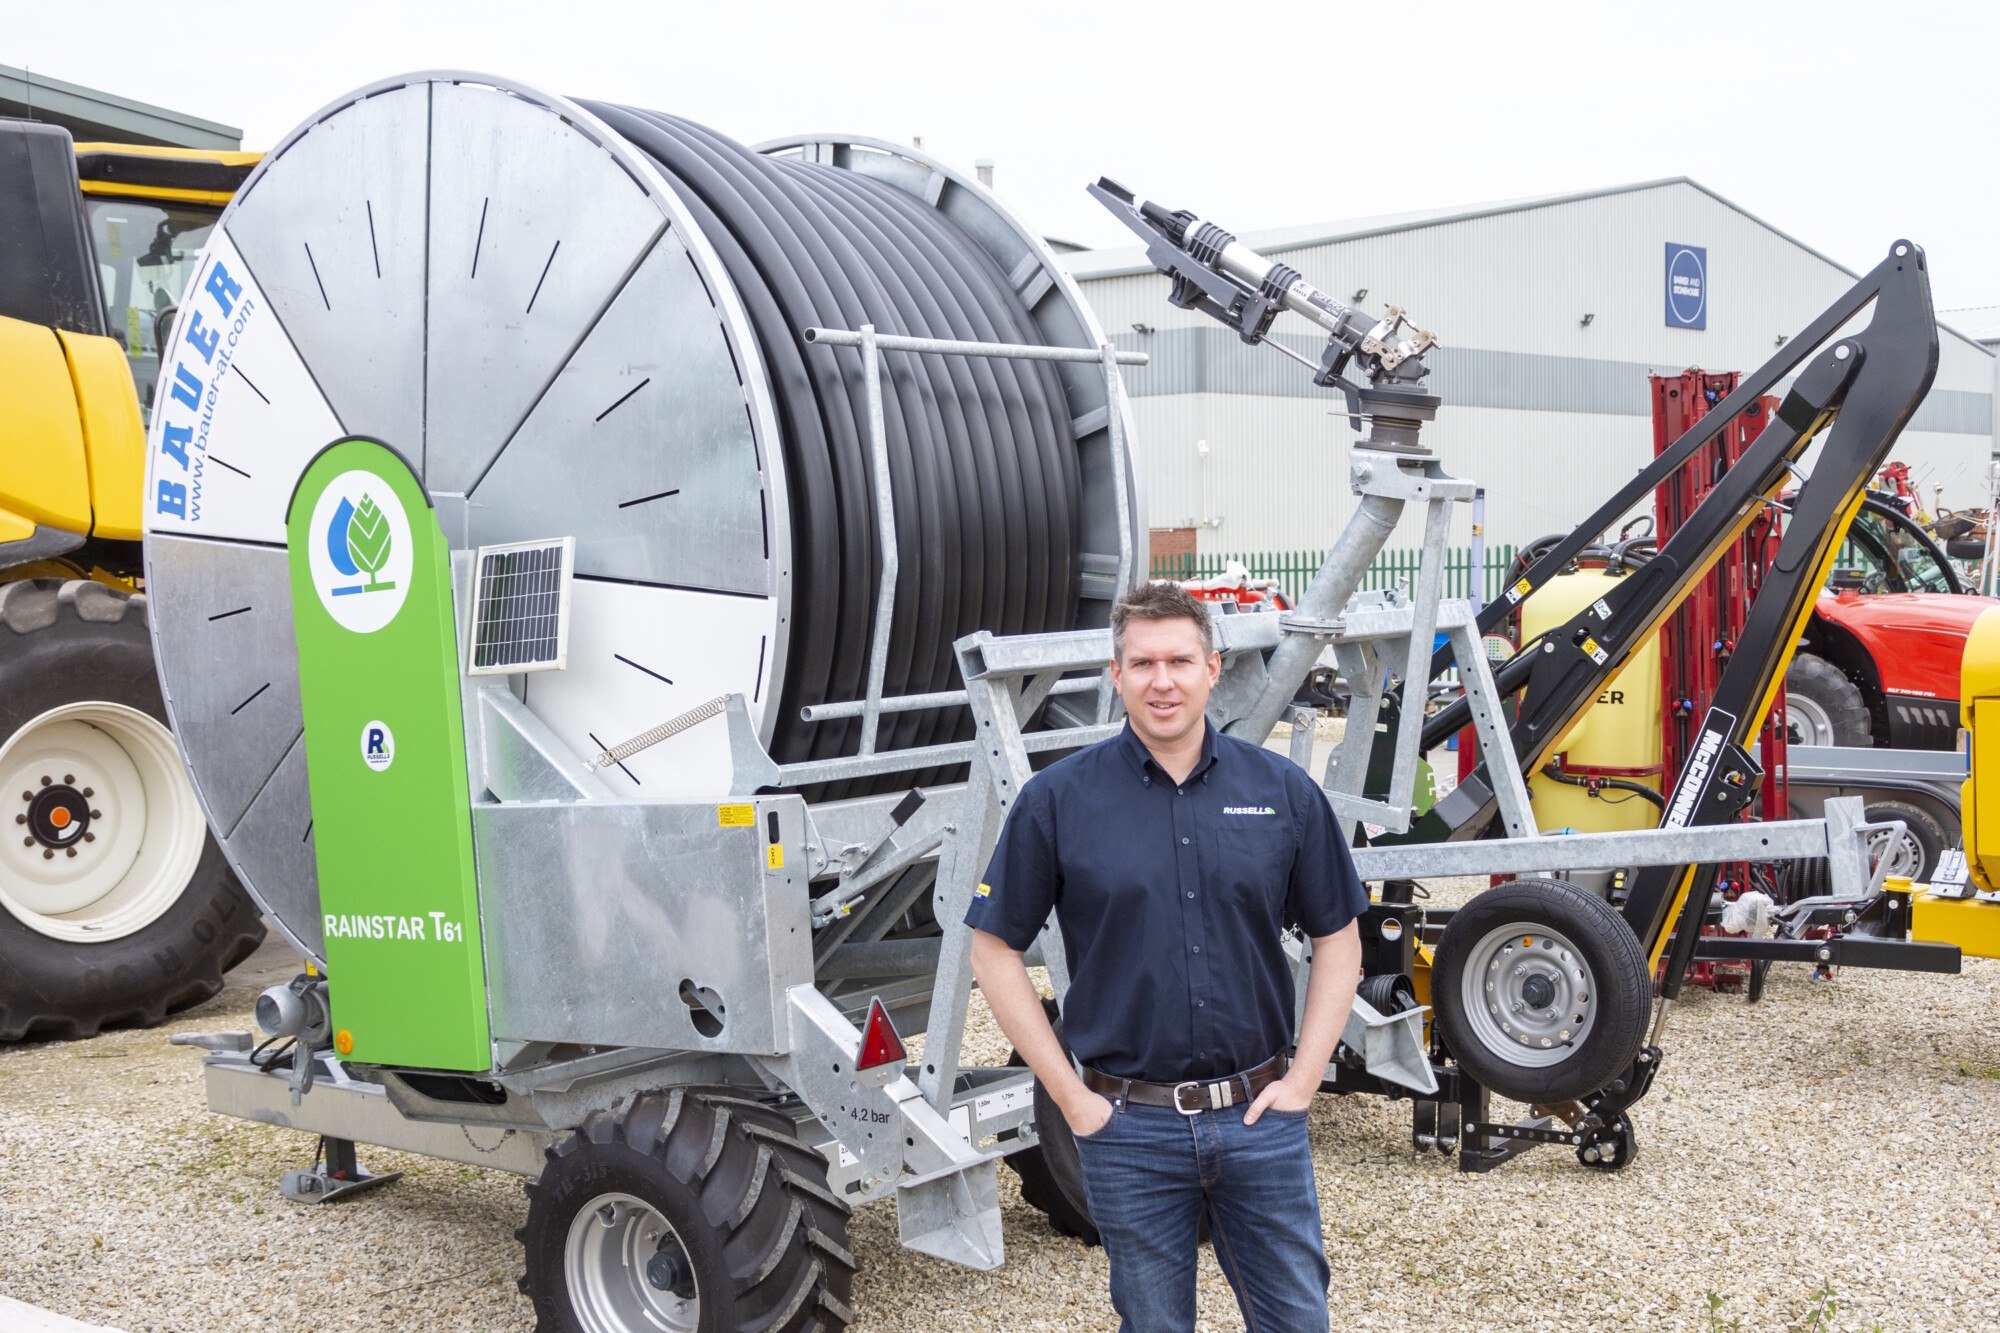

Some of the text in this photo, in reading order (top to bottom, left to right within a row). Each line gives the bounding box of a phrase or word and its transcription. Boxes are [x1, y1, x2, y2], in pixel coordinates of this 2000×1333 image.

[157, 261, 243, 520] BAUER
[190, 298, 256, 522] www.bauer-at.com
[1597, 691, 1624, 704] ER
[1664, 728, 1723, 829] McCONNE
[1223, 806, 1271, 815] RUSSELLS
[324, 911, 463, 943] RAINSTAR T61
[850, 1107, 890, 1124] 4,2 bar
